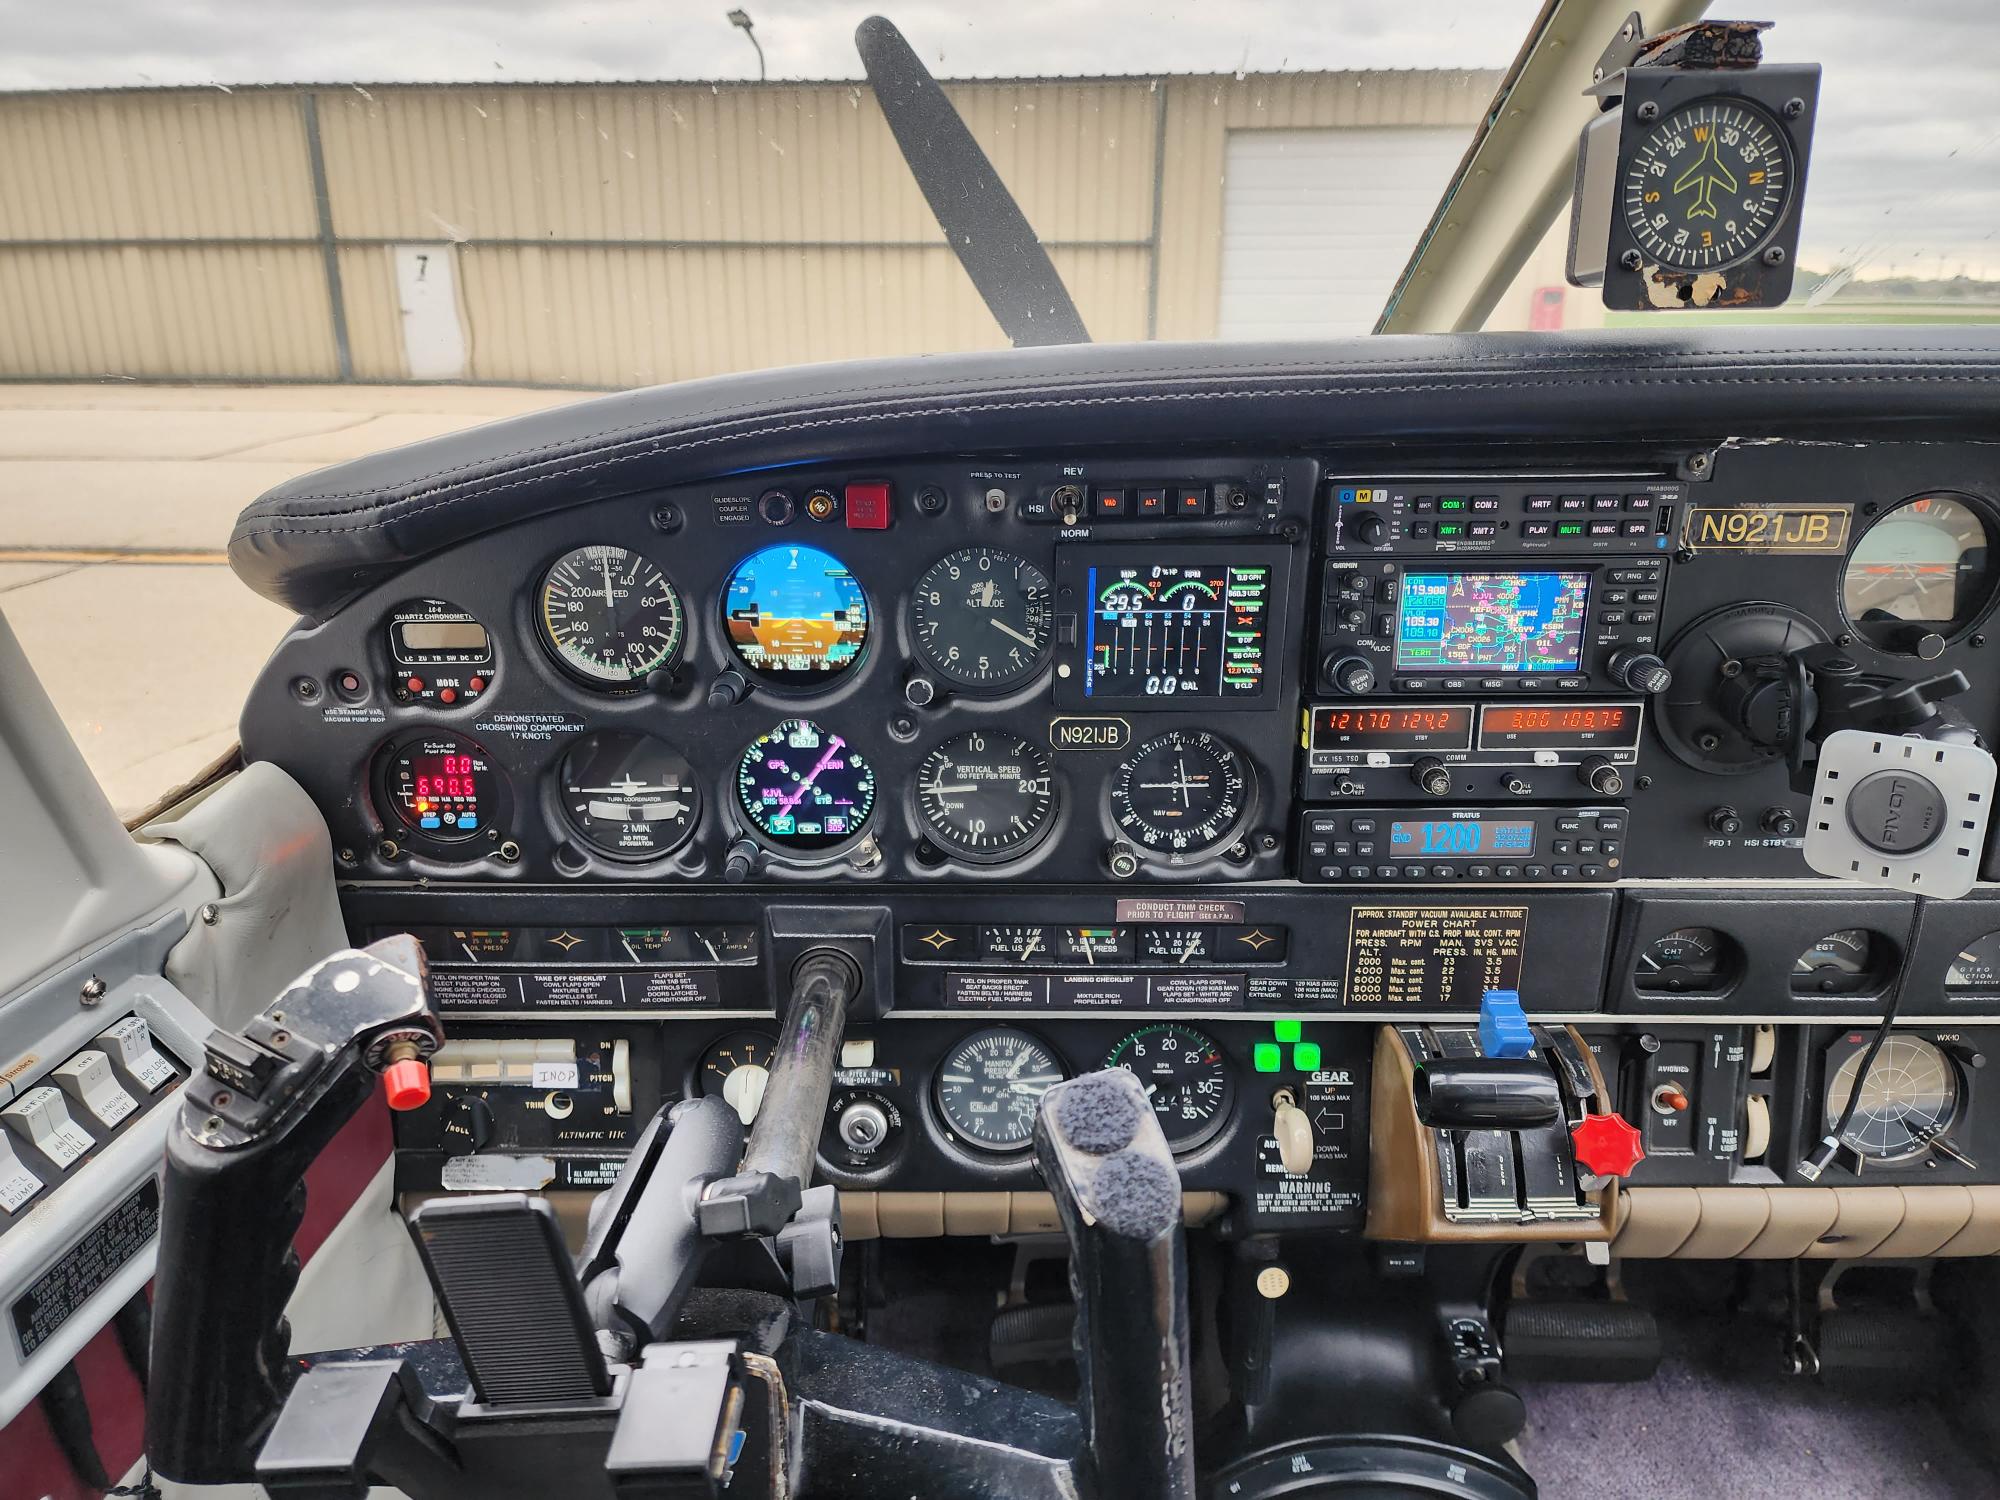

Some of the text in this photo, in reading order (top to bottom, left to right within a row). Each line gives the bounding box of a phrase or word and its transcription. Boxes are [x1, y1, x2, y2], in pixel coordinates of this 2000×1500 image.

[1694, 127, 1709, 142] W
[1720, 128, 1739, 146] 30
[1666, 136, 1686, 158] 24
[1740, 142, 1760, 163] 33
[1651, 162, 1667, 177] 21
[1749, 171, 1765, 185] N
[1644, 192, 1660, 203] S
[1743, 200, 1758, 213] 3
[1651, 214, 1669, 230] 15
[1725, 220, 1736, 235] 6
[1674, 228, 1690, 246] 12
[1702, 232, 1711, 246] E
[417, 255, 428, 281] 7
[1029, 505, 1044, 513] HSI
[1061, 529, 1089, 537] NORM
[1700, 514, 1831, 543] N921JB
[979, 557, 990, 571] 0
[950, 566, 960, 580] 9
[1185, 570, 1201, 578] RPM
[620, 575, 635, 586] 40
[571, 587, 591, 598] 200
[930, 592, 940, 605] 8
[1027, 586, 1037, 600] 2
[567, 602, 584, 612] 180
[641, 597, 656, 607] 60
[1106, 595, 1143, 610] 29.5
[571, 622, 588, 631] 160
[642, 626, 657, 637] 80
[929, 622, 939, 635] 7
[628, 643, 645, 653] 100
[948, 646, 959, 660] 6
[979, 657, 989, 670] 5
[436, 679, 460, 687] MODE
[1146, 676, 1198, 695] 0.0 GAL
[494, 715, 564, 723] DEMONSTRATED
[475, 724, 585, 732] CROSSWIND COMPONENT
[522, 732, 551, 740] KNOTS
[969, 739, 985, 751] 10
[957, 765, 992, 773] VERTICAL
[1019, 780, 1037, 793] 20
[1882, 780, 1908, 846] PIVOT
[623, 824, 652, 833] 2 MIN.
[969, 820, 985, 832] 10
[1420, 822, 1481, 853] 1200
[1709, 839, 1725, 847] PFD
[1744, 839, 1787, 847] HSI STBY
[1117, 860, 1131, 871] OBS
[1127, 911, 1196, 919] PRIOR TO FLIGHT
[1387, 911, 1418, 919] STANDBY
[1402, 920, 1477, 928] POWER CHART
[1358, 958, 1381, 966] 2000
[1355, 967, 1382, 975] 4000
[1354, 976, 1382, 984] 6000
[1353, 985, 1381, 993] 8000
[1351, 994, 1382, 1002] 10000
[1162, 1038, 1177, 1050] 20
[1135, 1045, 1146, 1057] 15
[1185, 1052, 1200, 1064] 25
[540, 1071, 576, 1082] INOP
[1312, 1072, 1349, 1082] GEAR
[1198, 1082, 1213, 1093] 30
[97, 1092, 128, 1117] LANDING
[833, 1098, 845, 1112] OFF
[110, 1103, 131, 1120] LIGHT
[1182, 1107, 1197, 1119] 35
[557, 1131, 604, 1139] ALTIMATIC
[1279, 1182, 1331, 1193] WARNING
[8, 1183, 35, 1206] PUMP
